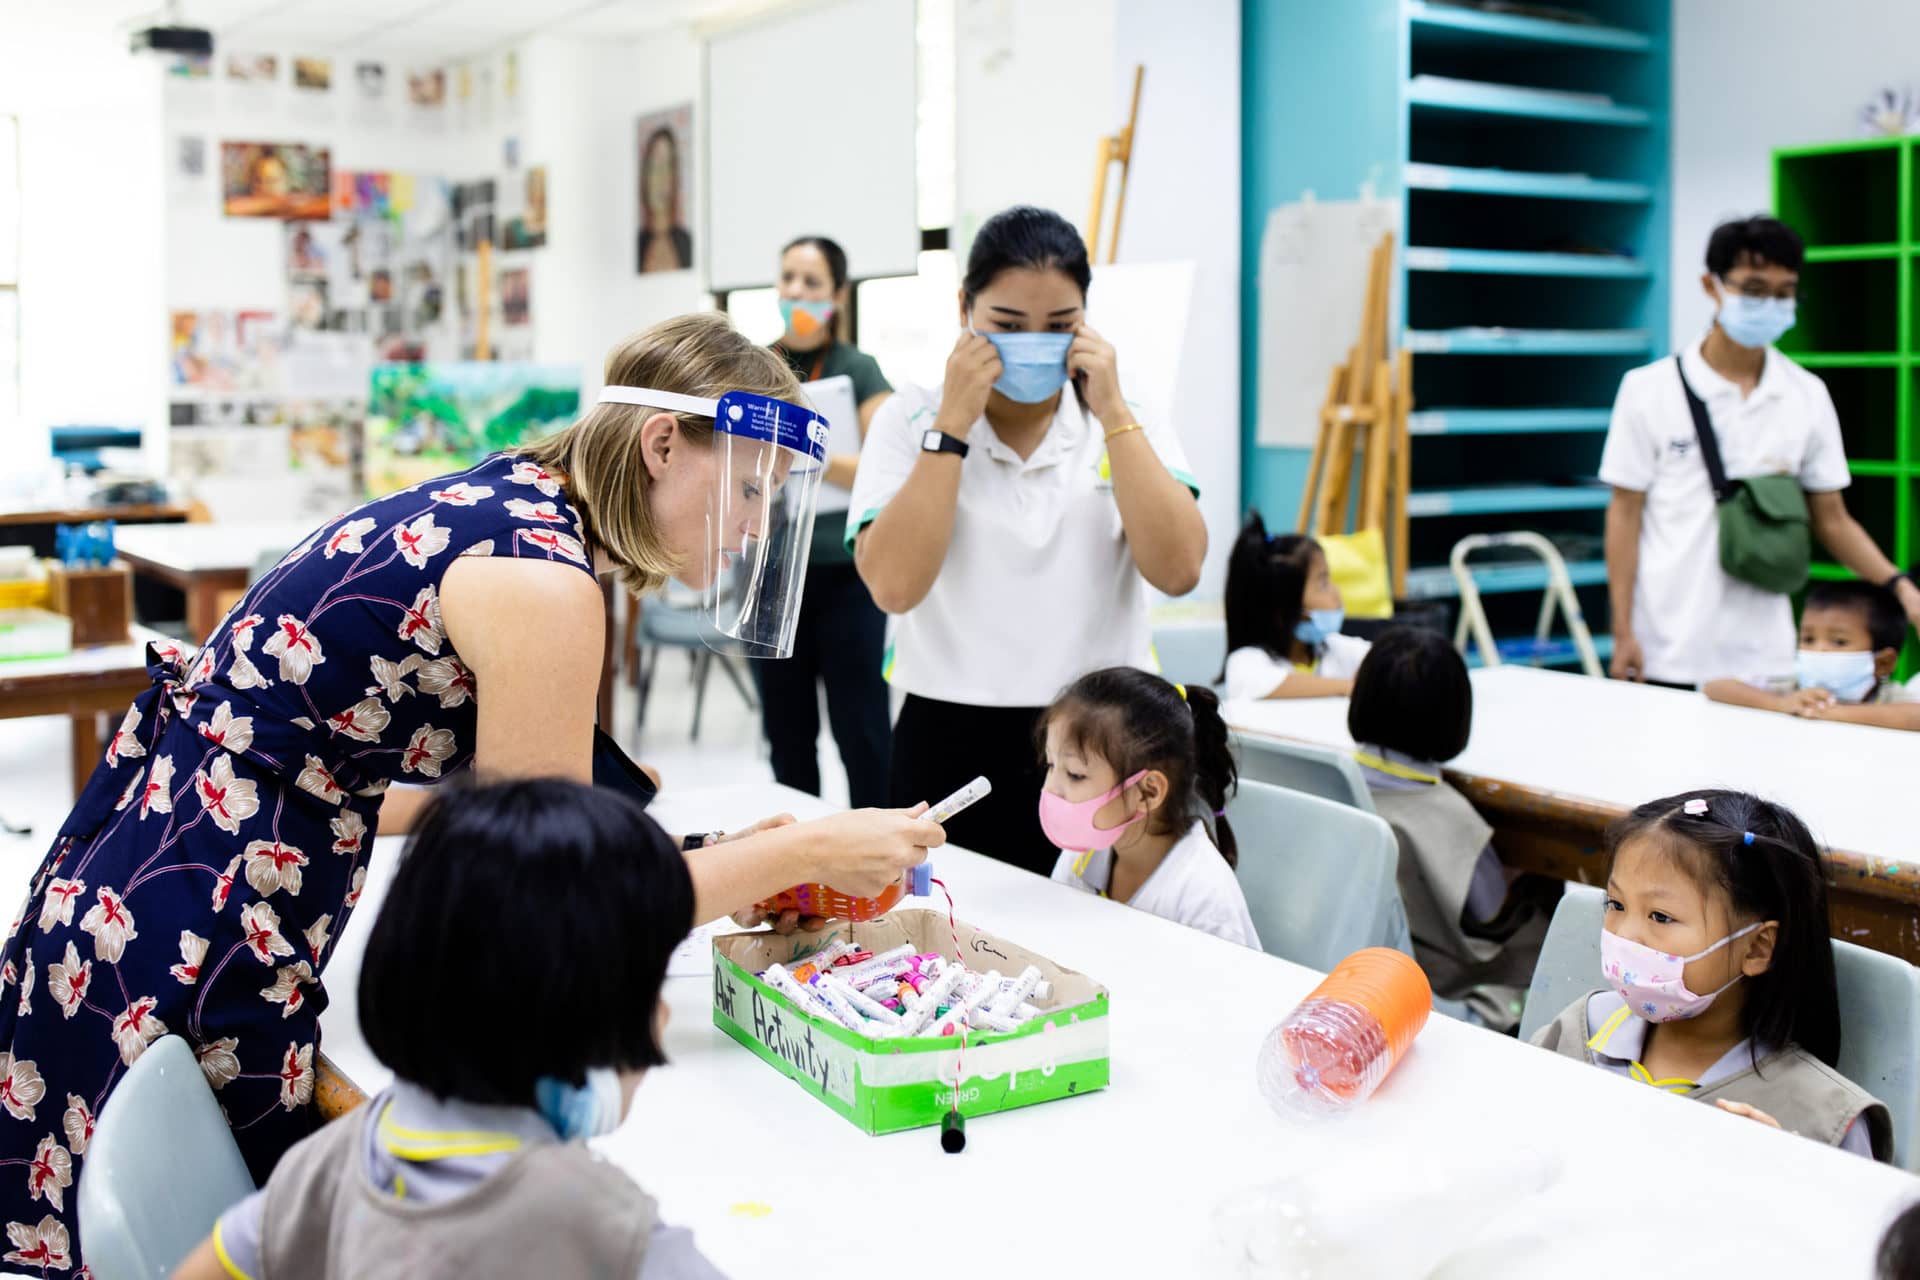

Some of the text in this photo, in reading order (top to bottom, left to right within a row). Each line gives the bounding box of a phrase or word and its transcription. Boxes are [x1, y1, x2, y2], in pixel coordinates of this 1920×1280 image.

[747, 403, 776, 415] Warnig:
[715, 963, 829, 1096] Art Activity
[934, 1087, 981, 1106] GREN
